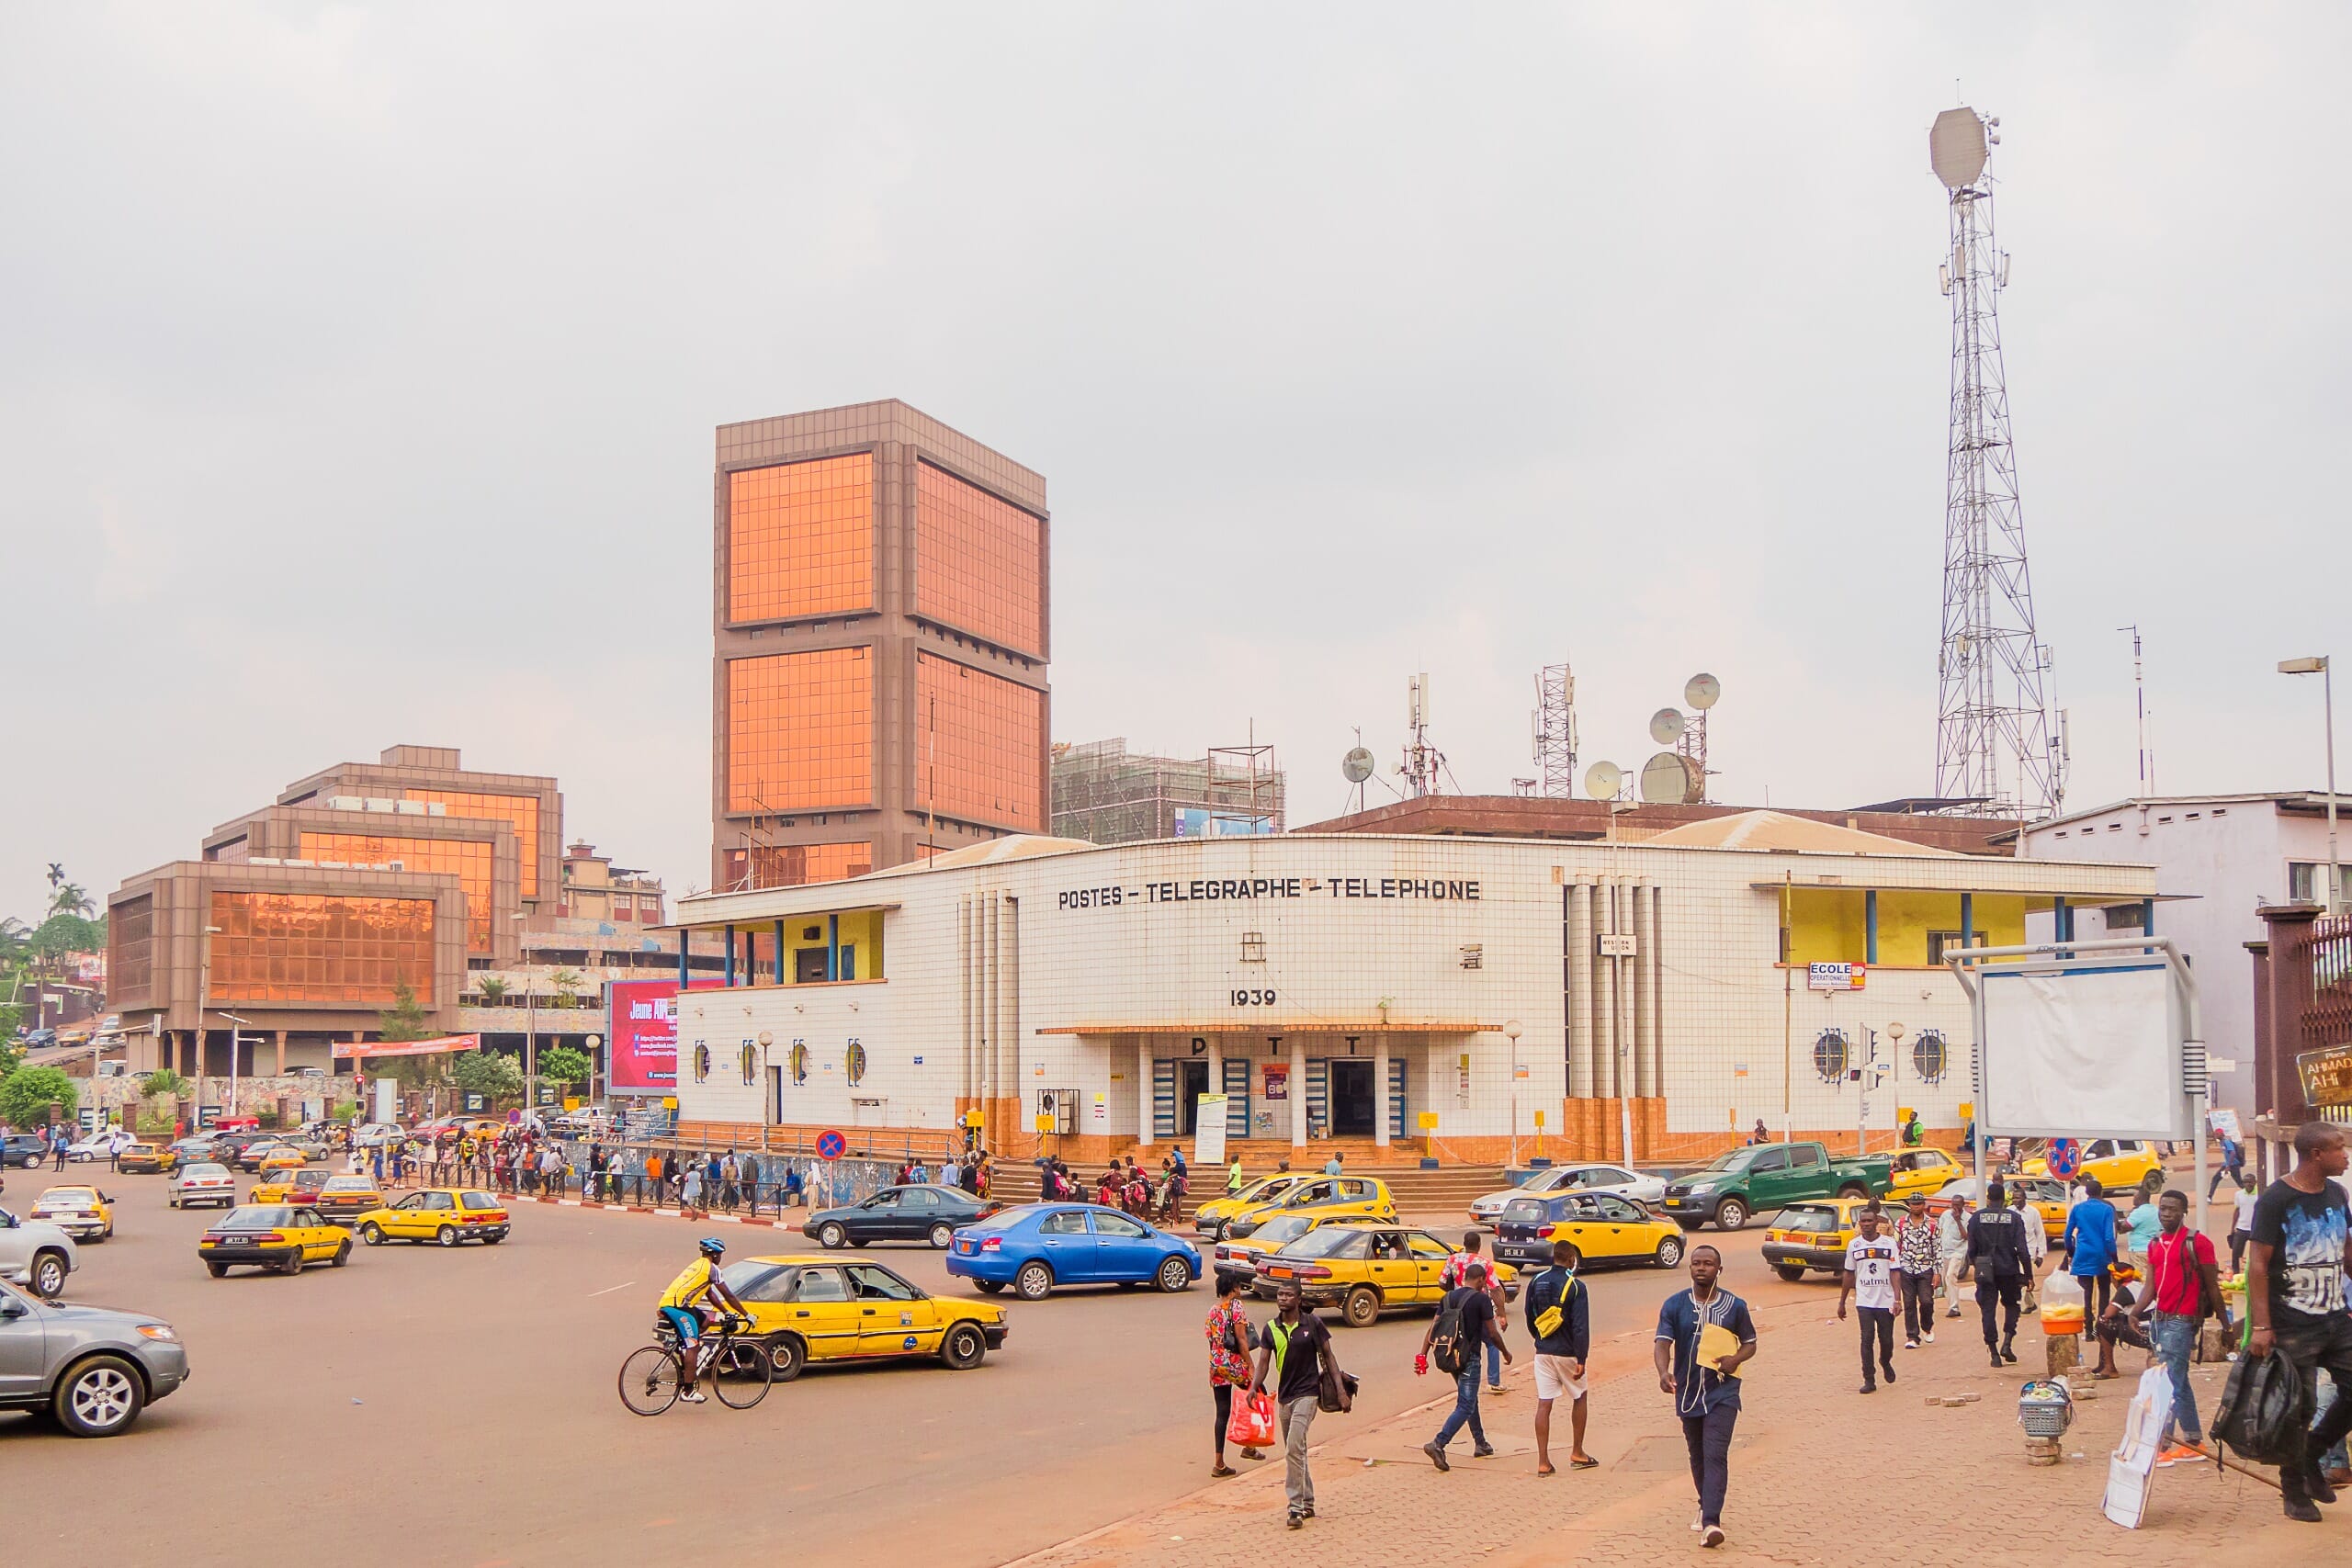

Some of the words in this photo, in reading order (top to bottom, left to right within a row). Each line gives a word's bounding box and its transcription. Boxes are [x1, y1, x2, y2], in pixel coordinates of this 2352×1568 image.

[1058, 886, 1122, 910] POSTES
[1146, 878, 1301, 903] TELEGRAPHE
[1327, 878, 1480, 900] TELEPHONE
[1230, 989, 1276, 1007] 1939
[629, 999, 652, 1020] Jeune
[1192, 1037, 1206, 1055] P
[1267, 1036, 1283, 1055] T
[1345, 1036, 1360, 1055] T
[1980, 1213, 2011, 1223] POLCE
